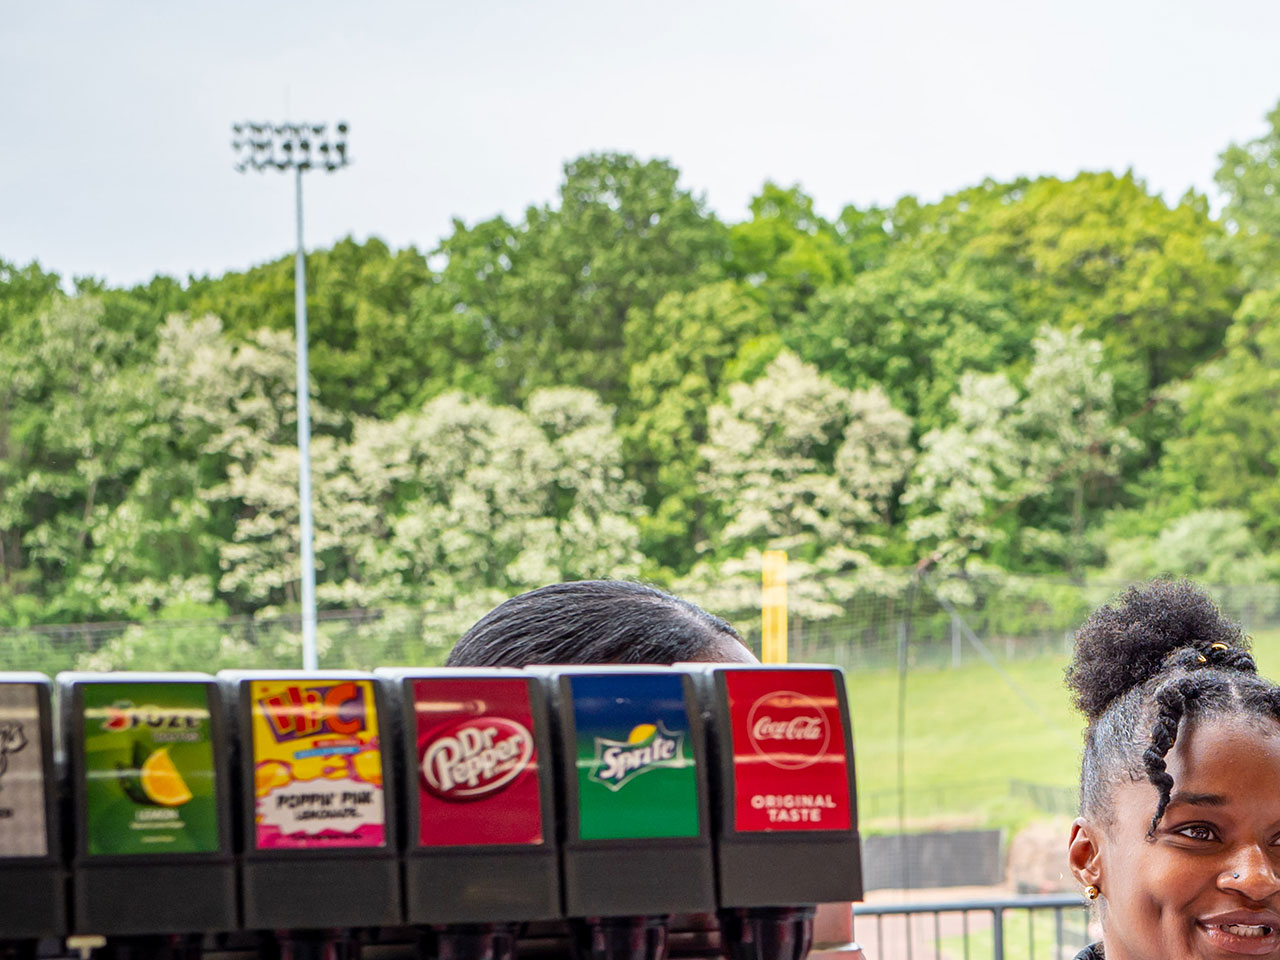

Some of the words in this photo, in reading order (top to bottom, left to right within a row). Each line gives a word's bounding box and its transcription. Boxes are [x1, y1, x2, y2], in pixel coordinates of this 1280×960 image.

[456, 727, 498, 756] Dr
[423, 733, 523, 792] Pepper
[599, 737, 676, 781] Sprite
[750, 795, 836, 809] ORIGINAL
[767, 809, 821, 823] TASTE
